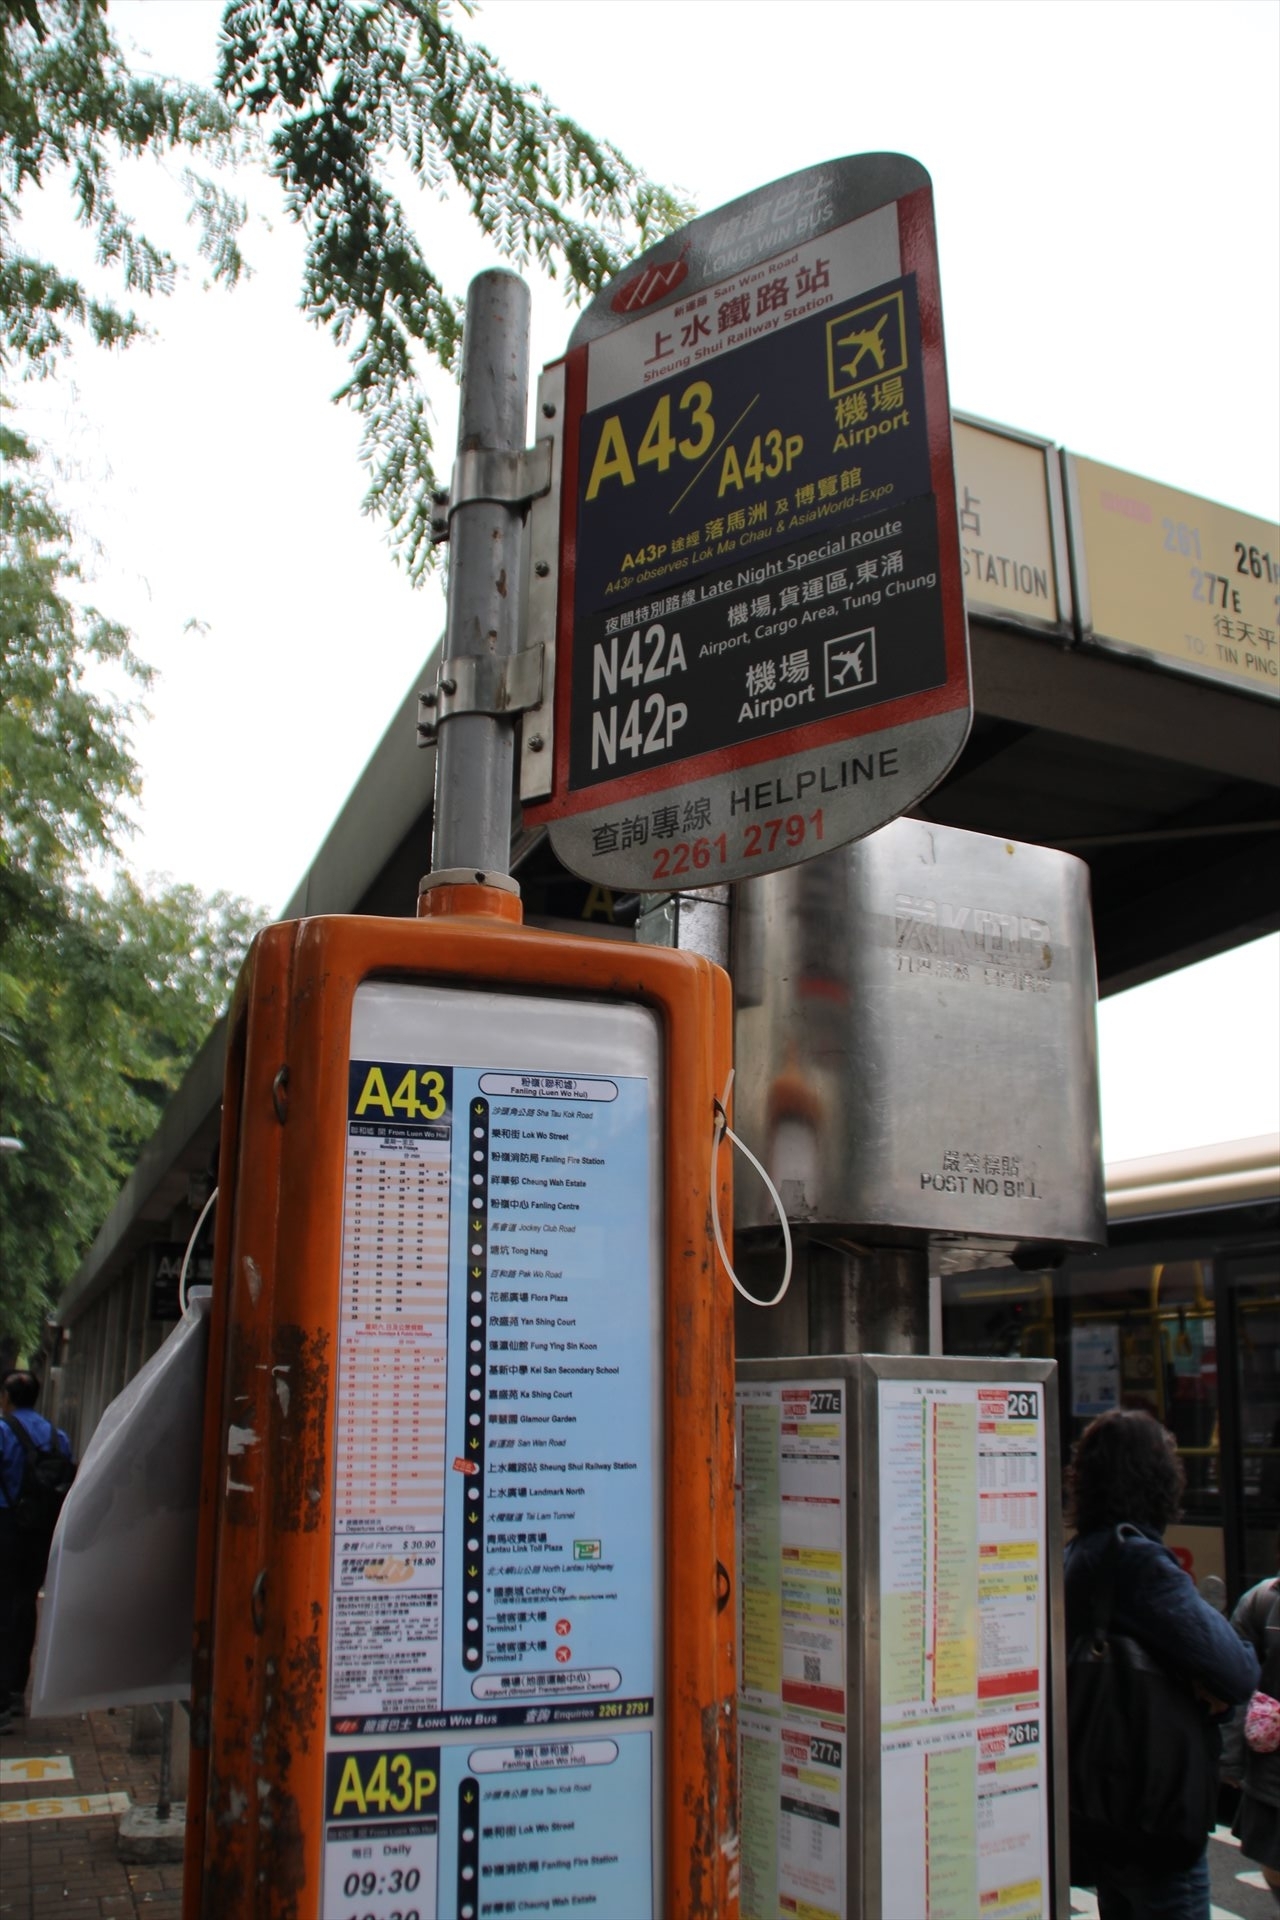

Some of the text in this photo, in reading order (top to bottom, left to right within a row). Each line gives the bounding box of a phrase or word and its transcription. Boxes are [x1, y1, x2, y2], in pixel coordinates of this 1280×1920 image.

[702, 204, 833, 277] LONG WIN BUS
[714, 284, 735, 299] San
[739, 270, 765, 288] Wan
[769, 253, 799, 273] Road
[644, 258, 830, 366] 上水鐵路站
[643, 293, 833, 383] Sheung Shui Railway Station
[834, 376, 904, 430] 機場
[832, 410, 910, 453] Airport
[585, 381, 805, 501] A43 A43P
[621, 468, 862, 572] A43P 途經 落馬洲 及 博覽館
[636, 559, 689, 584] observes
[692, 548, 714, 564] Lok
[717, 540, 736, 557] Ma
[739, 527, 772, 550] Chau
[777, 521, 786, 533] &
[788, 483, 894, 529] AsiaWorld-Expo
[1162, 517, 1202, 561] 261
[605, 518, 902, 634] 夜間特別路線 Late Night Special Route
[699, 571, 937, 658] Airport, Cargo Area, Tung Chung
[1214, 614, 1277, 650] 往天平
[593, 623, 687, 700] N42A
[1216, 643, 1239, 665] TIN
[1246, 652, 1278, 676] PING
[745, 649, 810, 698] 機場
[738, 684, 816, 723] Airport
[591, 692, 689, 770] N42P
[592, 747, 899, 858] 查詢專線 HELPLINE
[652, 808, 826, 880] 2261 2791
[354, 1067, 446, 1120] A43
[511, 1087, 537, 1096] Fanling
[538, 1088, 560, 1097] (Luen
[573, 1090, 588, 1098] Hui)
[536, 1132, 548, 1140] Wo
[541, 1155, 605, 1165] Fanling Fire Station
[522, 1178, 548, 1187] Cheung
[566, 1179, 586, 1187] Estate
[920, 1172, 968, 1194] POST
[972, 1176, 999, 1196] NO
[531, 1202, 579, 1211] Fanling Centre
[519, 1224, 541, 1232] Jockey
[559, 1225, 576, 1233] Road
[512, 1247, 548, 1256] Tong Hang
[519, 1270, 532, 1278] Pak
[535, 1318, 555, 1327] Shing
[550, 1343, 564, 1351] Ying
[567, 1342, 577, 1350] Sin
[558, 1367, 594, 1375] Secondary
[531, 1391, 551, 1399] Shing
[811, 1393, 839, 1410] 277E
[1008, 1394, 1037, 1416] 261
[520, 1415, 550, 1423] Glamour
[549, 1439, 567, 1447] Road
[540, 1464, 566, 1472] Sheung
[585, 1463, 611, 1471] Railway
[529, 1488, 564, 1496] Landmark
[553, 1512, 575, 1520] Tunnel
[544, 1544, 563, 1552] Plaza
[562, 1564, 584, 1572] Lantau
[586, 1563, 614, 1572] Highway
[525, 1586, 566, 1595] Cathay City
[486, 1625, 517, 1633] Terminal
[486, 1654, 517, 1662] Terminal
[554, 1702, 649, 1720] Enquiries 2261 2791
[1008, 1724, 1038, 1743] 261P
[811, 1741, 839, 1763] 277P
[502, 1758, 530, 1769] Fanling
[333, 1753, 437, 1816] A43P
[519, 1822, 574, 1835] Lok Wo Street
[383, 1845, 412, 1856] Daily
[542, 1855, 618, 1871] Fanling Fire Station
[343, 1868, 420, 1898] 09:30
[518, 1900, 549, 1911] Cheung
